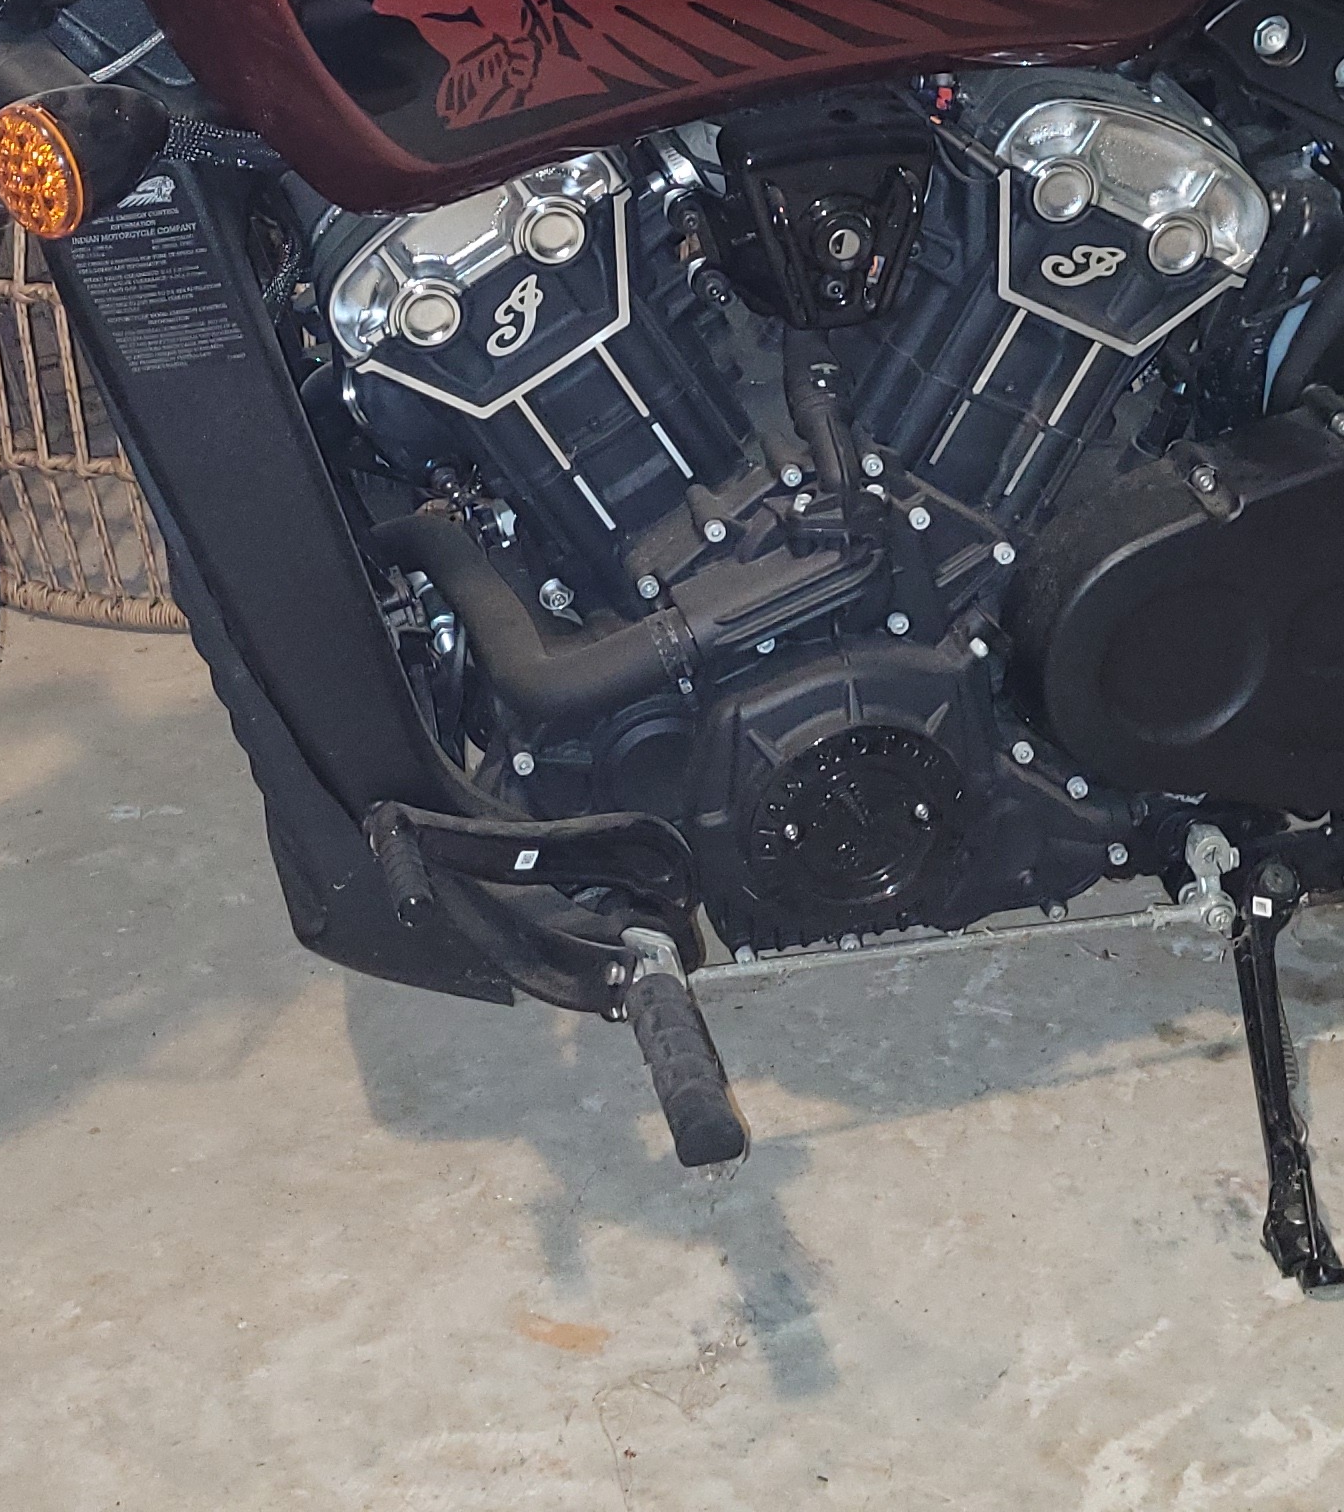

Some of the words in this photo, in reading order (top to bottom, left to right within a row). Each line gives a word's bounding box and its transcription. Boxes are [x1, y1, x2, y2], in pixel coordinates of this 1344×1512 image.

[71, 235, 101, 245] INDIAN
[101, 228, 156, 243] MOTORCYCLE
[157, 222, 197, 235] COMPANY
